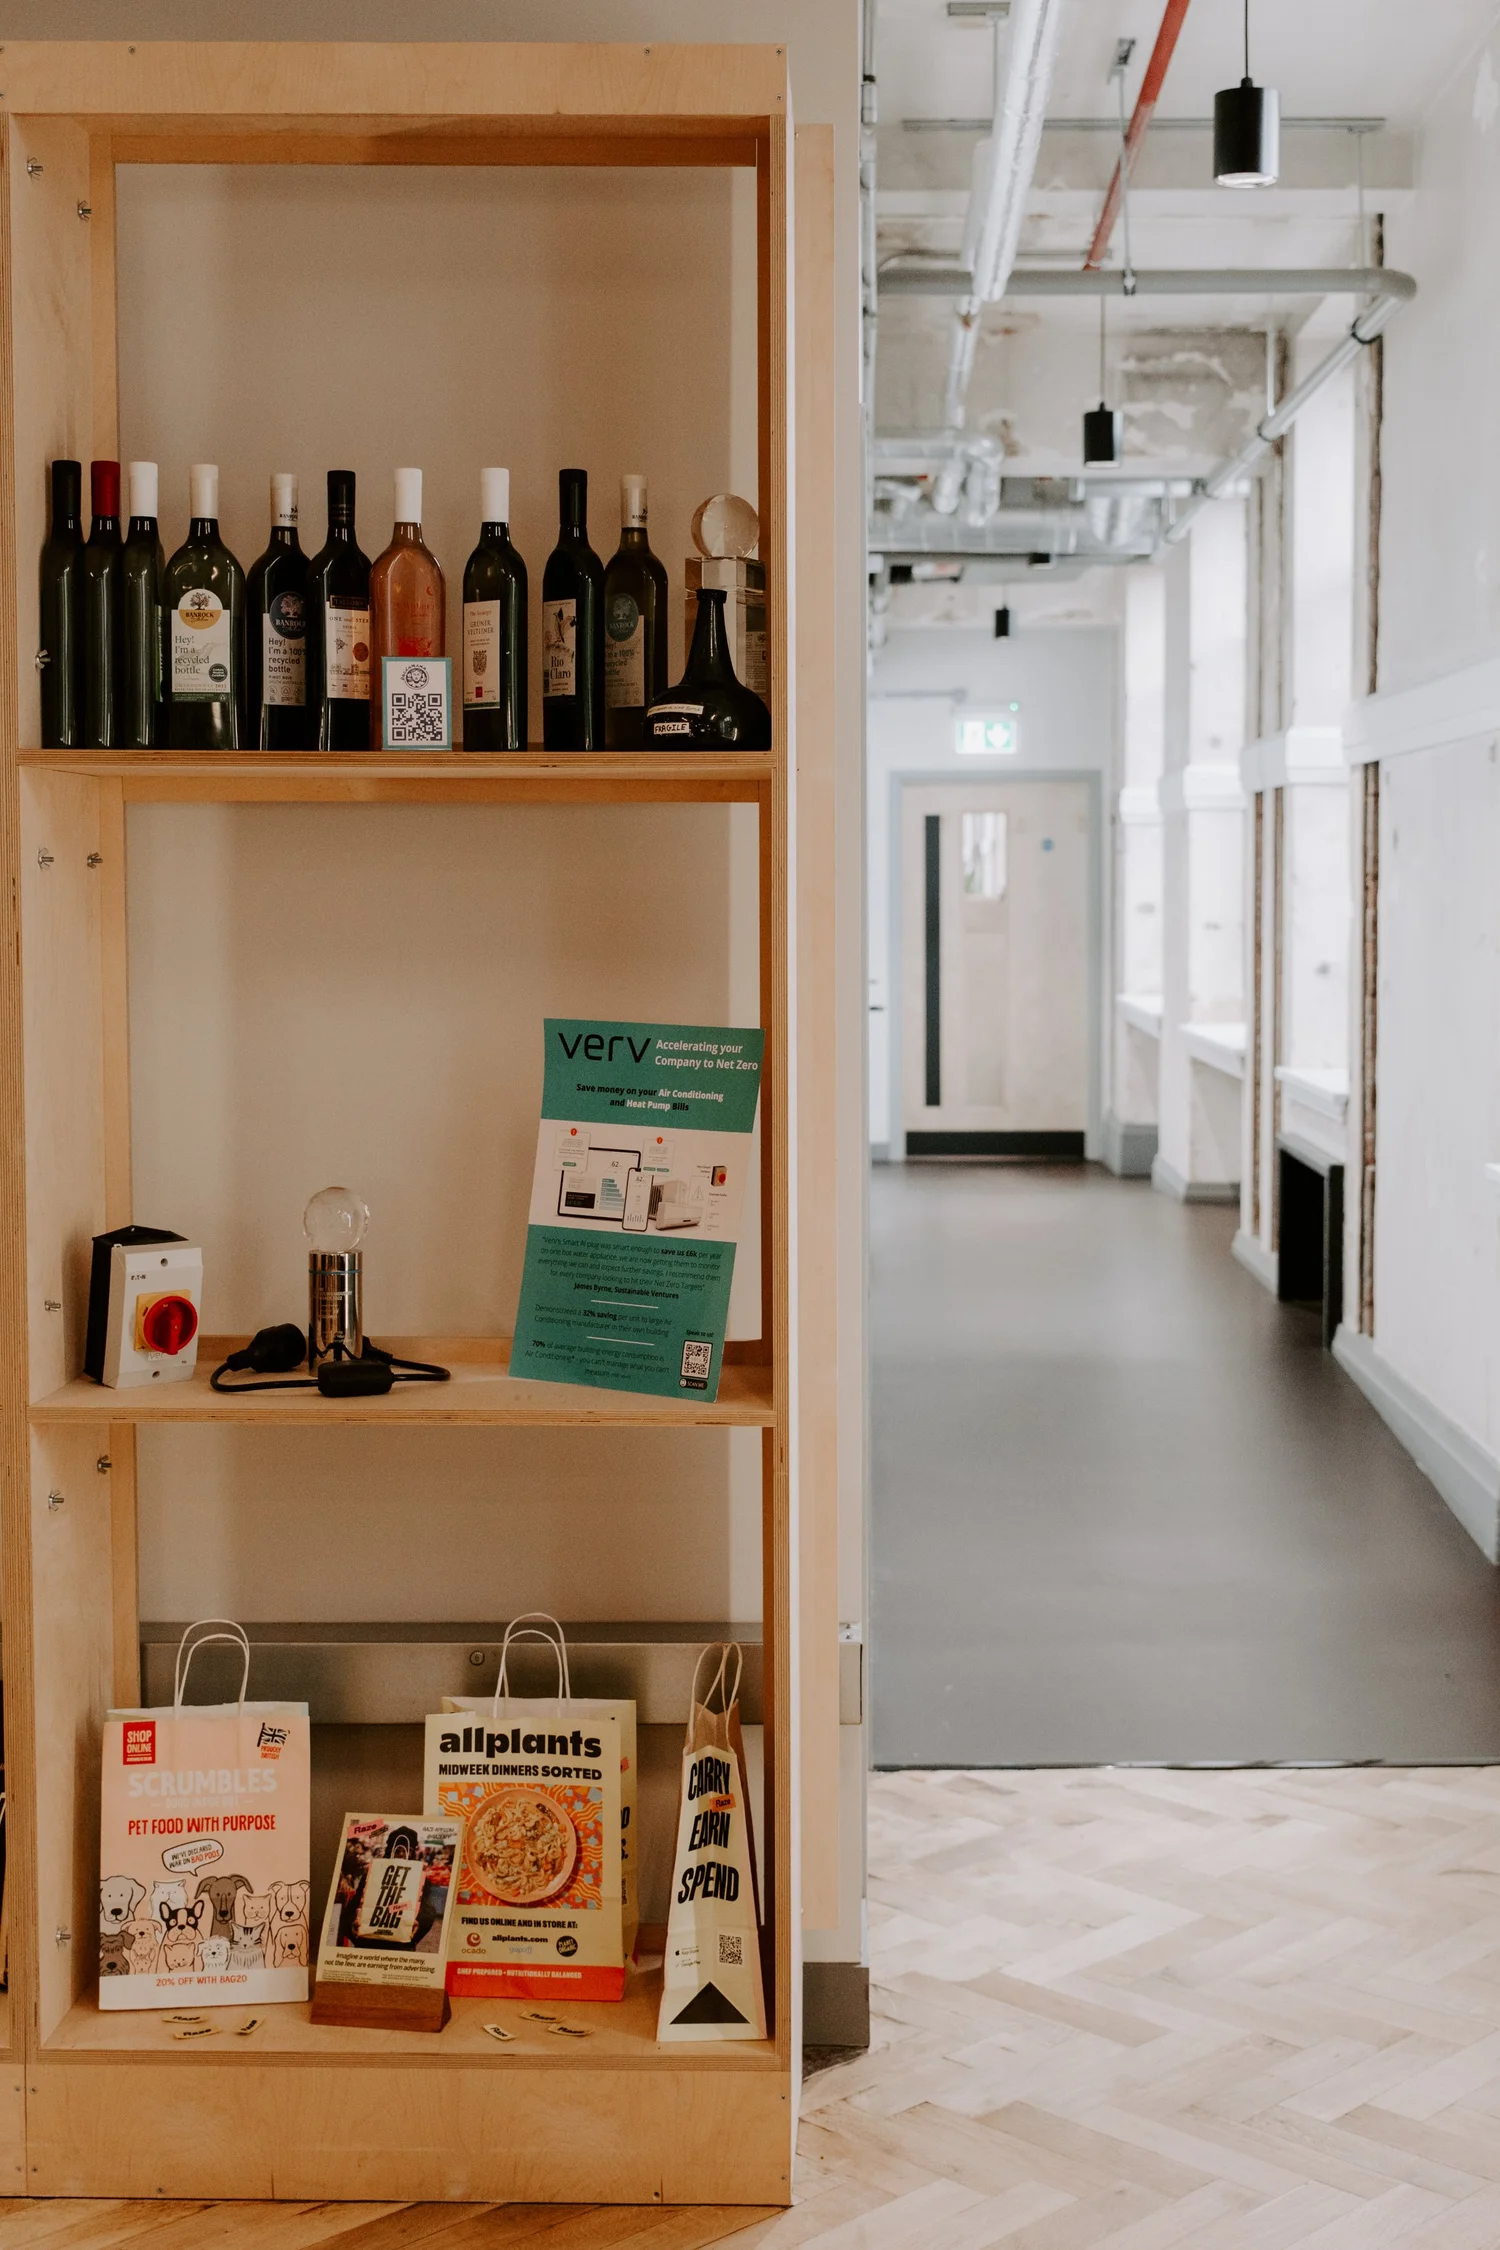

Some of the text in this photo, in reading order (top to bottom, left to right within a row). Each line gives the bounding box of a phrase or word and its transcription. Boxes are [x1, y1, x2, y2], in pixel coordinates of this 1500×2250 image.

[175, 636, 195, 646] Hey!
[268, 638, 286, 646] Hey!
[268, 647, 280, 655] I'm
[174, 656, 210, 668] recycled
[268, 656, 300, 665] recycled
[174, 666, 200, 674] bottle
[550, 668, 570, 680] Claro
[655, 723, 687, 733] FRAGILE
[558, 1032, 652, 1064] verv
[656, 1040, 743, 1055] Accelerating your
[655, 1056, 758, 1070] Company to Net Zero
[576, 1084, 595, 1092] Save
[598, 1086, 624, 1096] money
[638, 1088, 658, 1098] your
[658, 1088, 670, 1098] Air
[672, 1090, 724, 1102] Conditioning
[610, 1098, 689, 1112] and Heat Pump Bills
[562, 1238, 578, 1246] Smart
[587, 1242, 599, 1250] plug
[631, 1246, 652, 1254] enough
[538, 1258, 567, 1268] everything
[670, 1271, 704, 1280] recommend
[652, 1258, 674, 1267] getting
[576, 1272, 602, 1280] company
[602, 1274, 622, 1284] looking
[666, 1280, 680, 1288] Zero
[573, 1282, 592, 1290] James
[614, 1286, 650, 1296] Sustainable
[650, 1290, 680, 1299] Ventures
[535, 1304, 577, 1316] Demonstrated
[582, 1310, 596, 1318] 32%
[597, 1312, 618, 1322] saving
[649, 1316, 663, 1326] large
[534, 1315, 571, 1327] Conditioning
[646, 1328, 668, 1338] building
[554, 1344, 576, 1352] average
[578, 1346, 600, 1356] building
[602, 1349, 621, 1358] energy
[622, 1352, 658, 1362] consumption
[128, 1730, 152, 1743] SHOP
[440, 1726, 602, 1758] allplants
[126, 1743, 152, 1754] ONLINE
[439, 1764, 602, 1780] MIDWEEK DINNERS SORTED
[688, 1756, 730, 1801] CARRY
[128, 1768, 278, 1798] SCRUMBLES
[716, 1798, 731, 1808] Raze
[128, 1814, 276, 1835] PET FOOD WITH PURPOSE
[354, 1824, 378, 1834] Raze
[688, 1808, 730, 1852] EARN
[188, 1844, 212, 1856] DECLARED
[169, 1860, 182, 1869] WAR
[190, 1854, 204, 1864] BAD
[204, 1850, 220, 1860] POOS
[381, 1864, 412, 1886] GET
[677, 1861, 740, 1904] SPEND
[376, 1886, 406, 1906] THE
[368, 1906, 404, 1928] BAG
[461, 1916, 578, 1929] FIND US ONLINE AND IN STORE AT:
[492, 1934, 548, 1943] allplants.com
[336, 1952, 358, 1961] Imagine
[367, 1963, 388, 1971] earning
[472, 1968, 502, 1976] PREPARED
[156, 1974, 248, 1987] 20% OFF WITH BAG20
[507, 1970, 582, 1980] NUTRITIONALLY BALANCED
